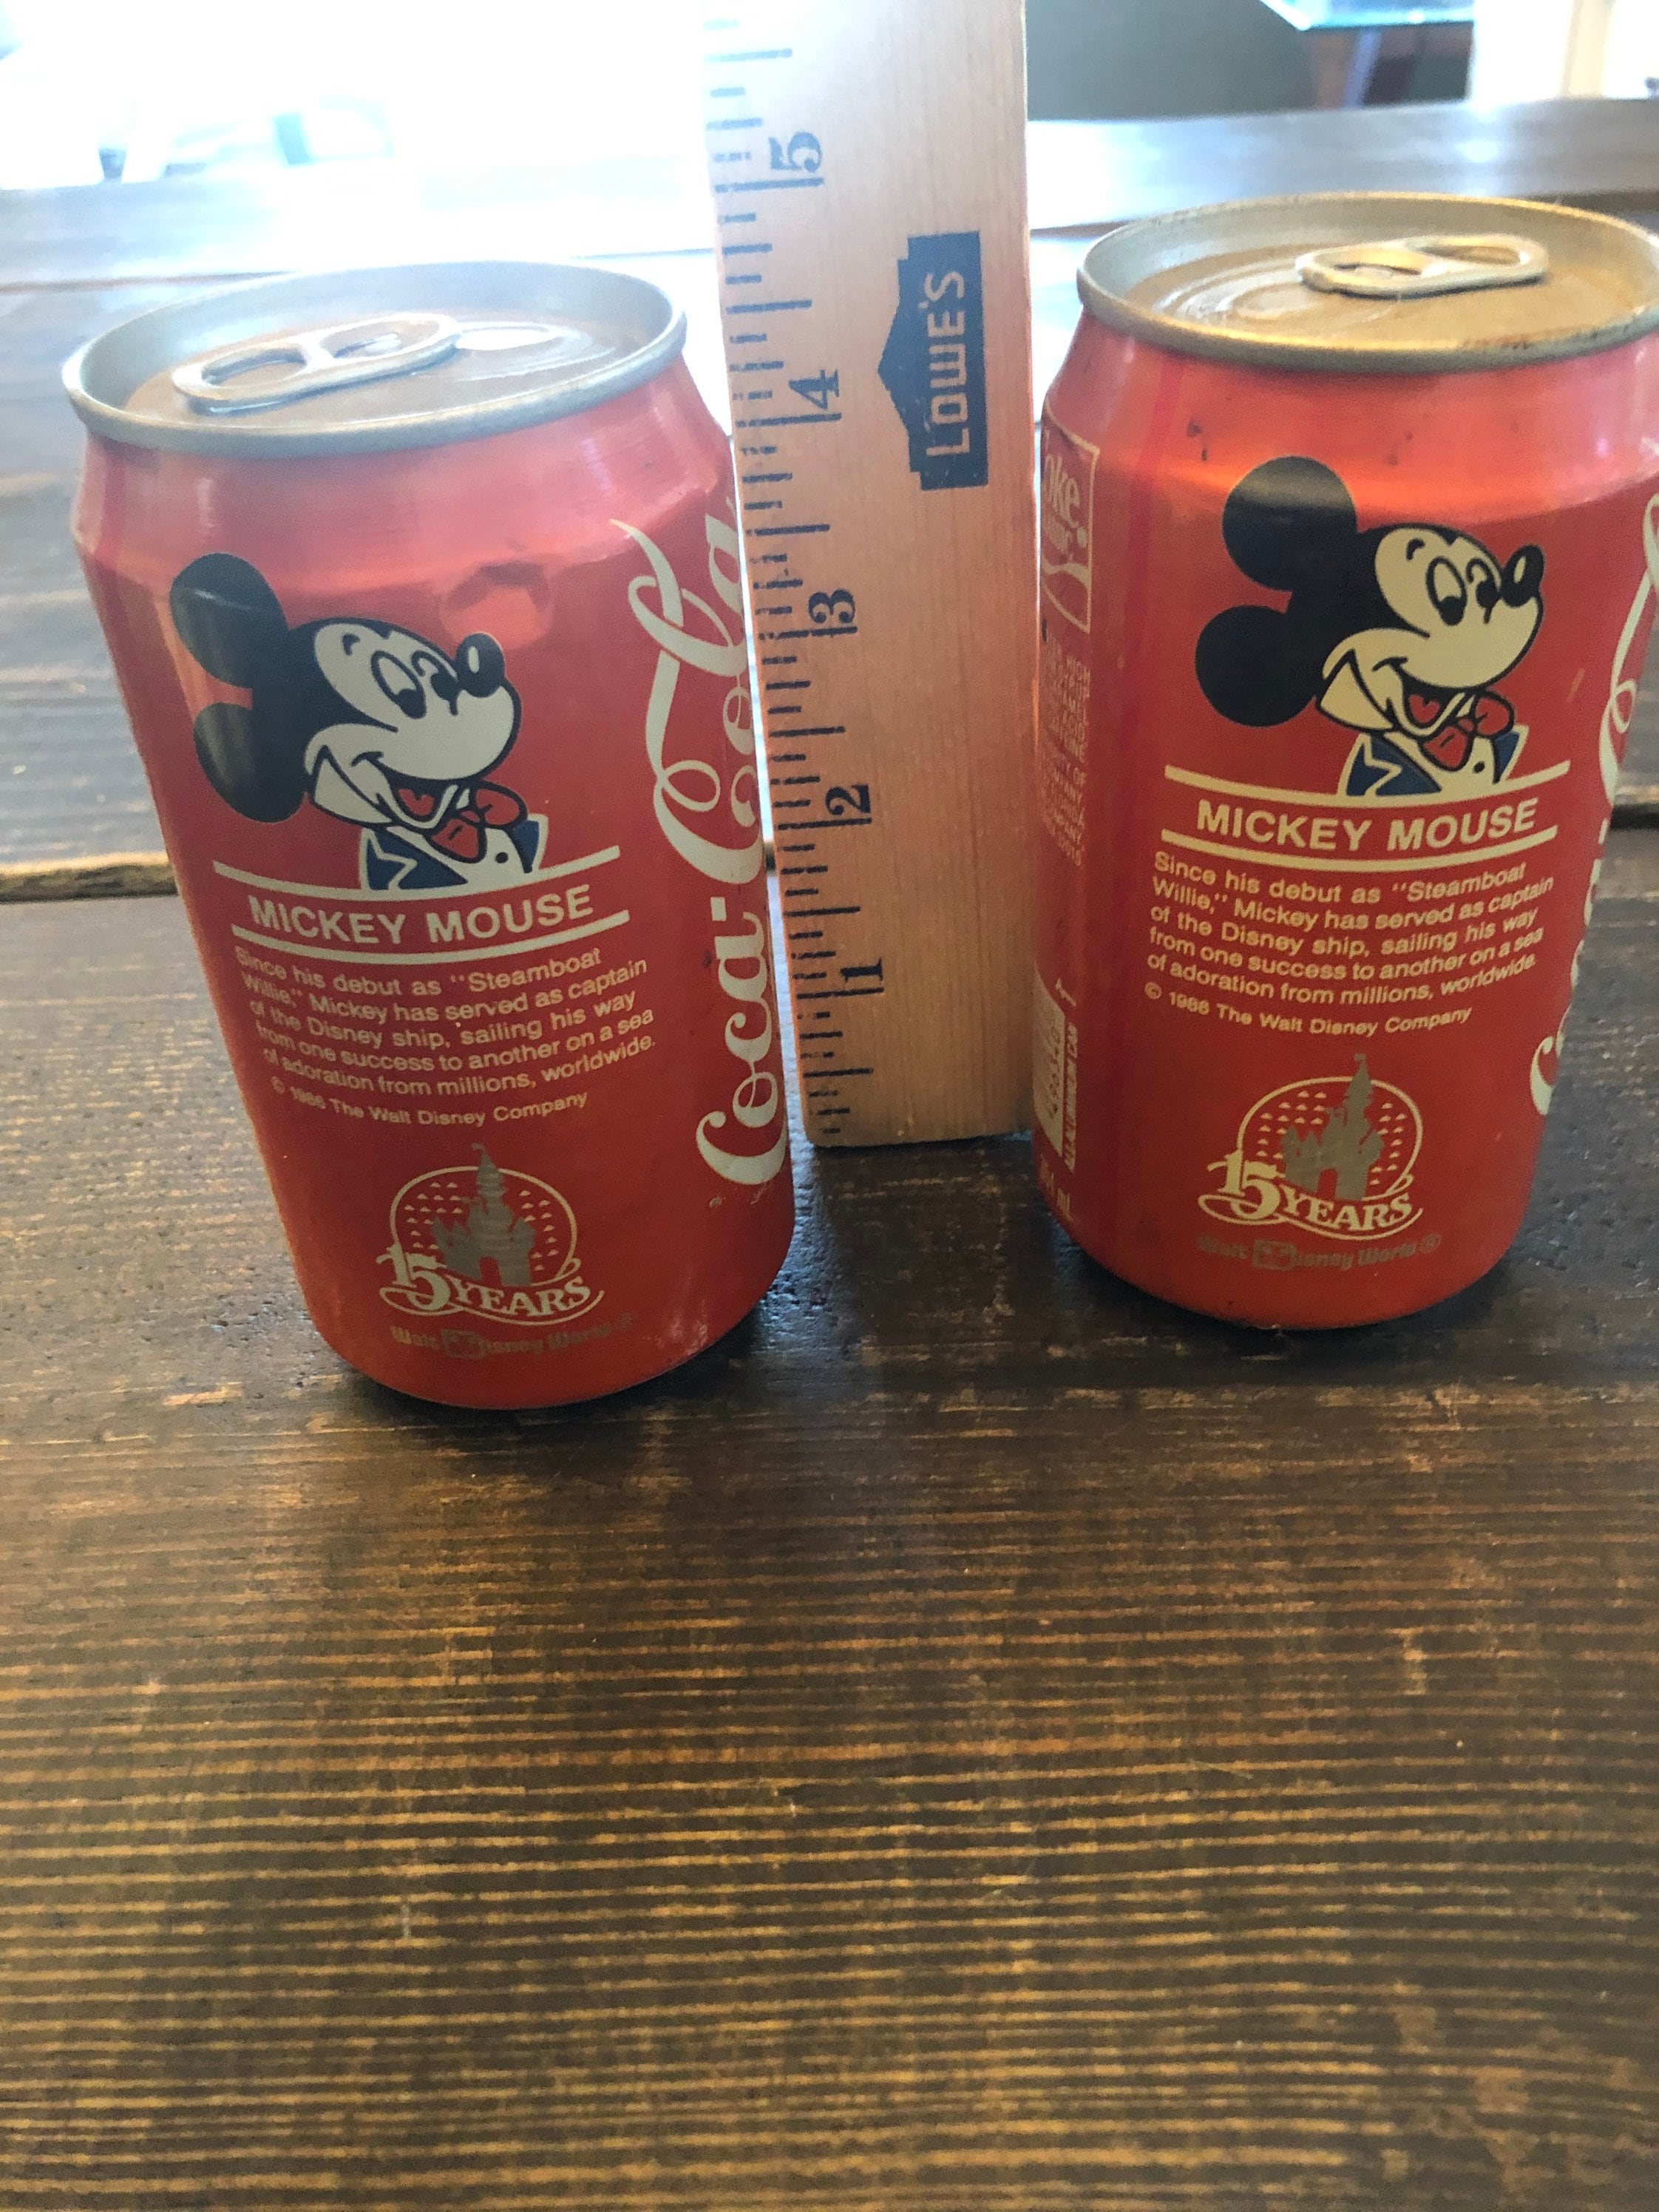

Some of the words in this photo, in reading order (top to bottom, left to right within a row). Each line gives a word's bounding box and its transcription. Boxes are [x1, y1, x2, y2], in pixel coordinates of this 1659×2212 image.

[768, 130, 823, 172] 5
[788, 369, 840, 410] 4
[918, 270, 970, 458] LOWE'S
[807, 588, 858, 625] 3
[824, 782, 872, 817] 2
[1196, 798, 1372, 851] MICKEY
[1386, 796, 1539, 851] MOUSE
[1154, 850, 1217, 886] Since
[1224, 869, 1261, 895] his
[1268, 878, 1342, 903] debut
[1351, 887, 1382, 904] as
[248, 894, 406, 945] MICKEY
[426, 883, 594, 944] MOUSE
[1234, 897, 1319, 933] Mickey
[1323, 909, 1369, 931] has
[1374, 902, 1455, 930] served
[1458, 900, 1485, 920] as
[1487, 876, 1554, 913] captain
[1149, 926, 1196, 957] from
[1200, 946, 1244, 968] one
[1247, 955, 1347, 980] success
[1351, 962, 1375, 980] to
[1379, 953, 1467, 980] another
[1469, 946, 1496, 966] on
[1498, 941, 1511, 958] a
[1513, 926, 1544, 952] sea
[1150, 906, 1171, 924] of
[1177, 911, 1213, 937] the
[1221, 920, 1305, 957] Disney
[1311, 935, 1370, 960] ship,
[1380, 930, 1459, 955] sailing
[1465, 920, 1496, 943] his
[1502, 906, 1539, 934] way
[234, 945, 288, 980] Since
[293, 963, 326, 988] his
[333, 972, 403, 997] debut
[412, 980, 443, 997] as
[308, 993, 389, 1025] Mickey
[393, 1002, 440, 1022] has
[445, 991, 529, 1021] served
[535, 988, 563, 1008] as
[567, 959, 648, 996] captain
[840, 958, 884, 985] 1
[1147, 953, 1167, 971] of
[1170, 961, 1274, 999] adoration
[1280, 982, 1334, 1005] from
[1340, 983, 1433, 1005] millions,
[249, 1000, 265, 1019] of
[269, 1005, 302, 1032] the
[307, 1016, 383, 1050] Disney
[392, 1028, 451, 1051] ship,
[460, 1020, 543, 1045] sailing
[550, 1008, 587, 1031] his
[594, 990, 636, 1018] way
[255, 1020, 296, 1051] from
[298, 1041, 337, 1062] one
[340, 1050, 435, 1072] success
[438, 1054, 463, 1071] to
[468, 1039, 560, 1071] another
[566, 1031, 595, 1052] on
[599, 1025, 614, 1042] a
[617, 1008, 654, 1035] sea
[1216, 1002, 1253, 1026] The
[1259, 1012, 1303, 1033] Walt
[1309, 1017, 1380, 1038] Disney
[1384, 1007, 1473, 1034] Company
[280, 1055, 375, 1085] adoration
[378, 1074, 432, 1096] from
[436, 1073, 537, 1096] millions,
[328, 1097, 365, 1119] The
[367, 1106, 412, 1124] Walt
[417, 1110, 486, 1128] Disney
[492, 1090, 588, 1122] Company
[1207, 1148, 1286, 1221] 15
[1279, 1184, 1413, 1232] YEARS
[376, 1239, 452, 1312] 15
[444, 1275, 592, 1317] YEARS
